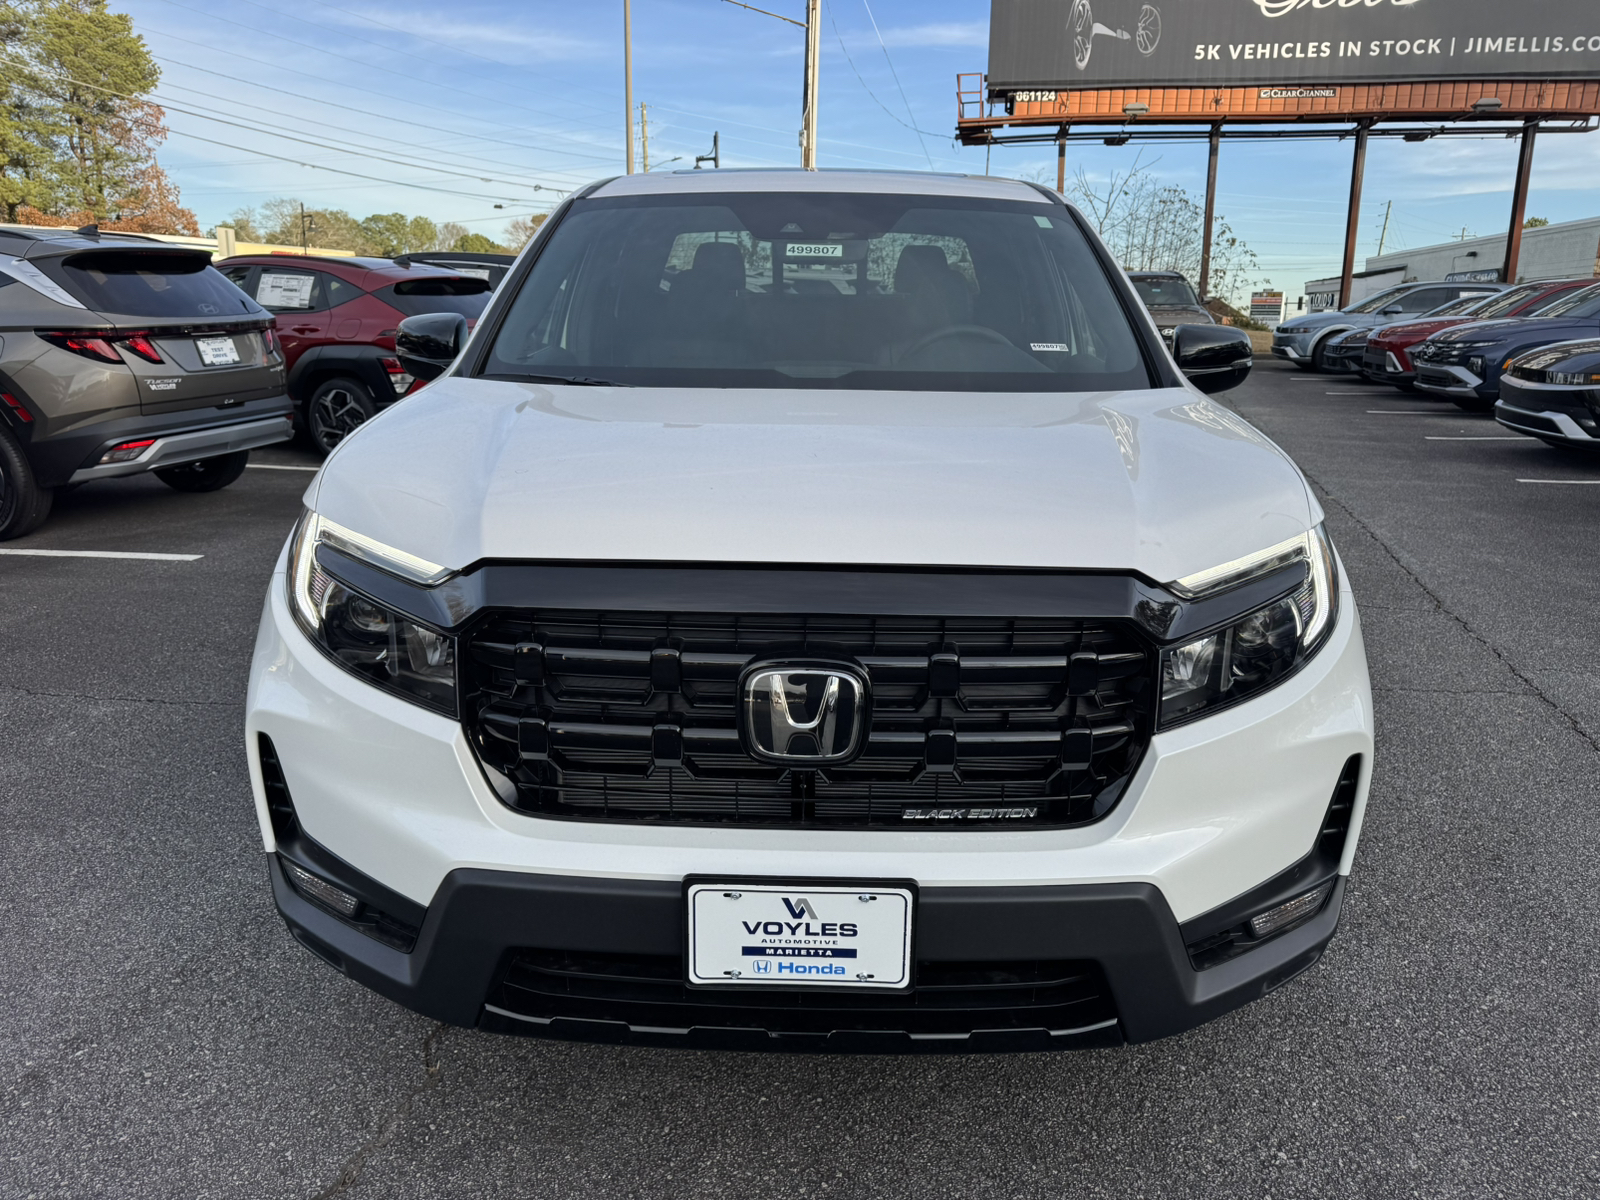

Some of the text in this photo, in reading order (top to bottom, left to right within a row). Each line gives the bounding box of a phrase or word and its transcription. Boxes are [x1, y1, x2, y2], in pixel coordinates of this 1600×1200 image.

[1194, 44, 1221, 60] 5K
[1228, 41, 1331, 60] VEHICLES
[1338, 41, 1362, 57] IN
[1369, 38, 1442, 56] STOCK
[787, 245, 838, 255] 499807
[902, 808, 1037, 819] BLACK EDITION
[741, 920, 858, 938] VOYLES
[765, 948, 833, 957] MARIETTA
[777, 961, 846, 975] Honda
